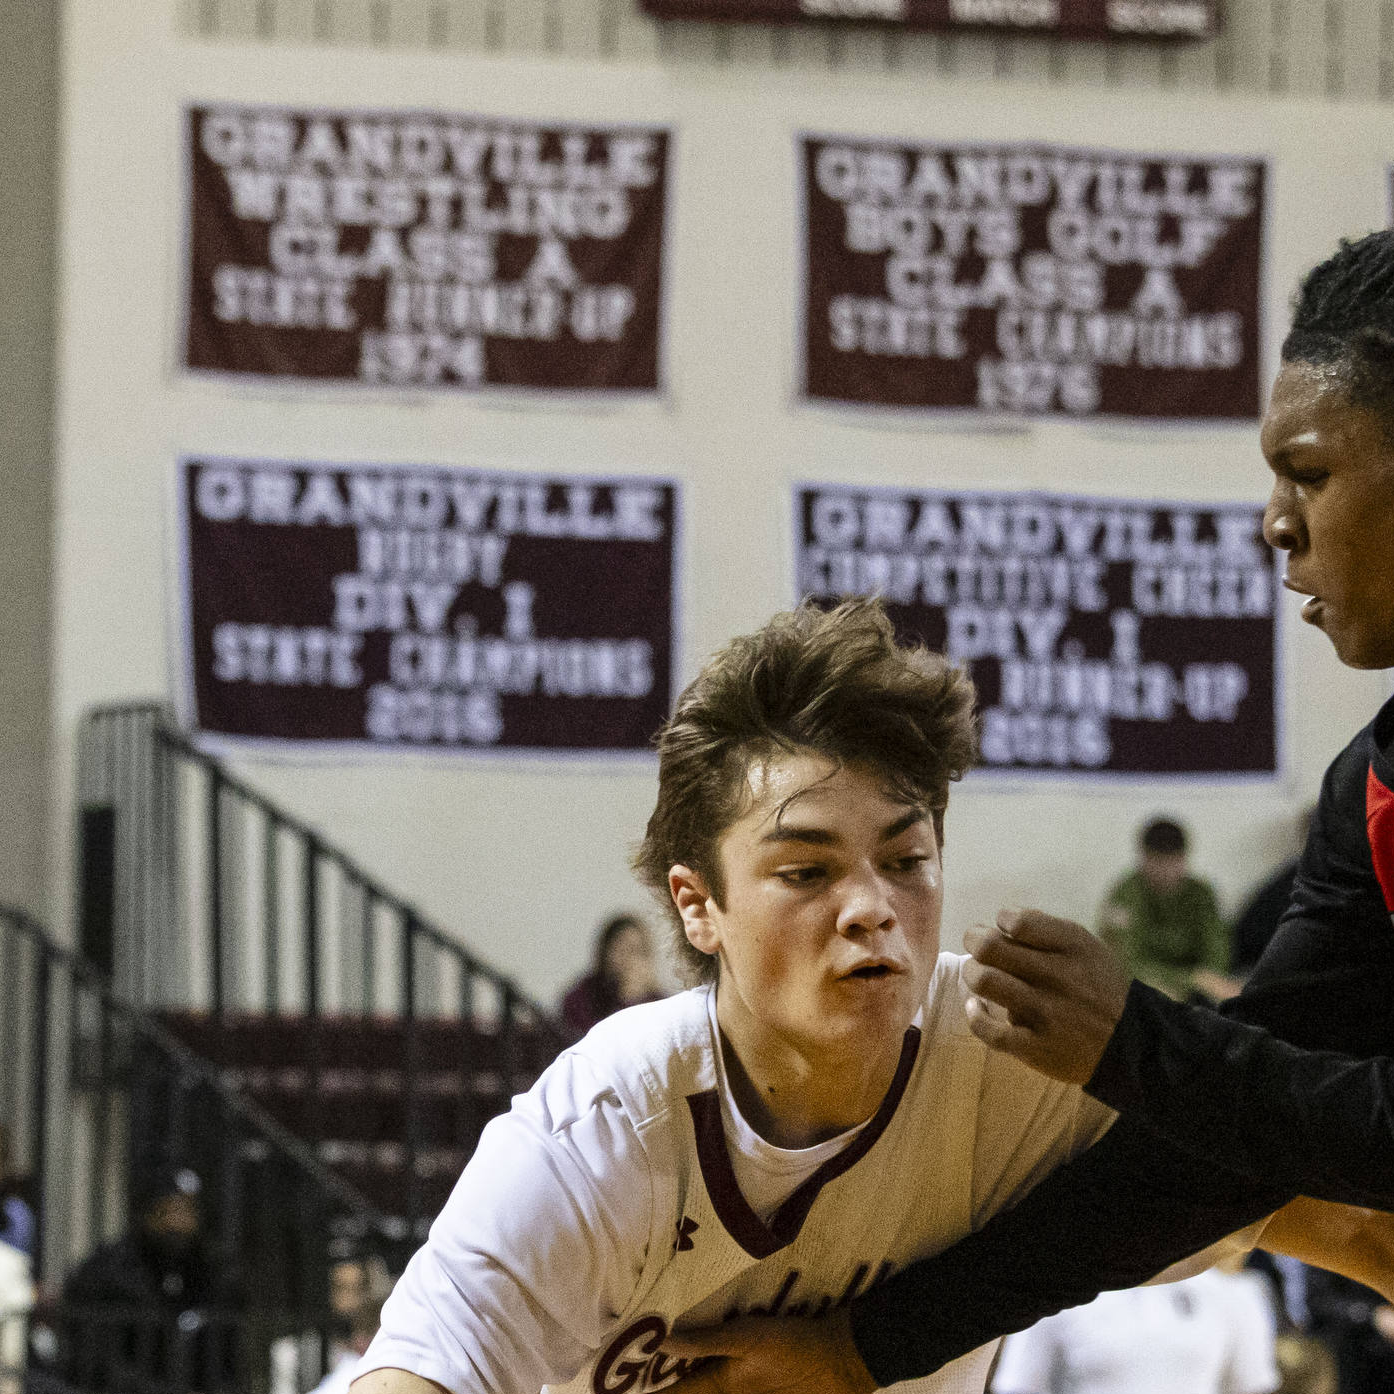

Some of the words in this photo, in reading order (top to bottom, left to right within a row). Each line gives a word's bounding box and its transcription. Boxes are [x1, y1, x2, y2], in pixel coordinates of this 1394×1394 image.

[202, 115, 656, 187] GRANDVILLE
[815, 144, 1253, 217] GRANDVILLE
[229, 166, 633, 239] WRESTLING
[845, 203, 1021, 259] BOYS
[1048, 208, 1226, 268] GOLF
[269, 221, 497, 284] CLASS
[527, 238, 579, 292] A
[884, 250, 1105, 310] CLASS
[1131, 264, 1184, 319] A
[212, 265, 356, 331] STATE
[827, 294, 967, 359] STATE
[996, 306, 1245, 369] CHAMPIONS
[195, 466, 667, 540] GRANDVILLE
[809, 499, 1269, 565] GRANDVILLE
[212, 621, 365, 689] STATE
[388, 633, 654, 698] CHAMPIONS
